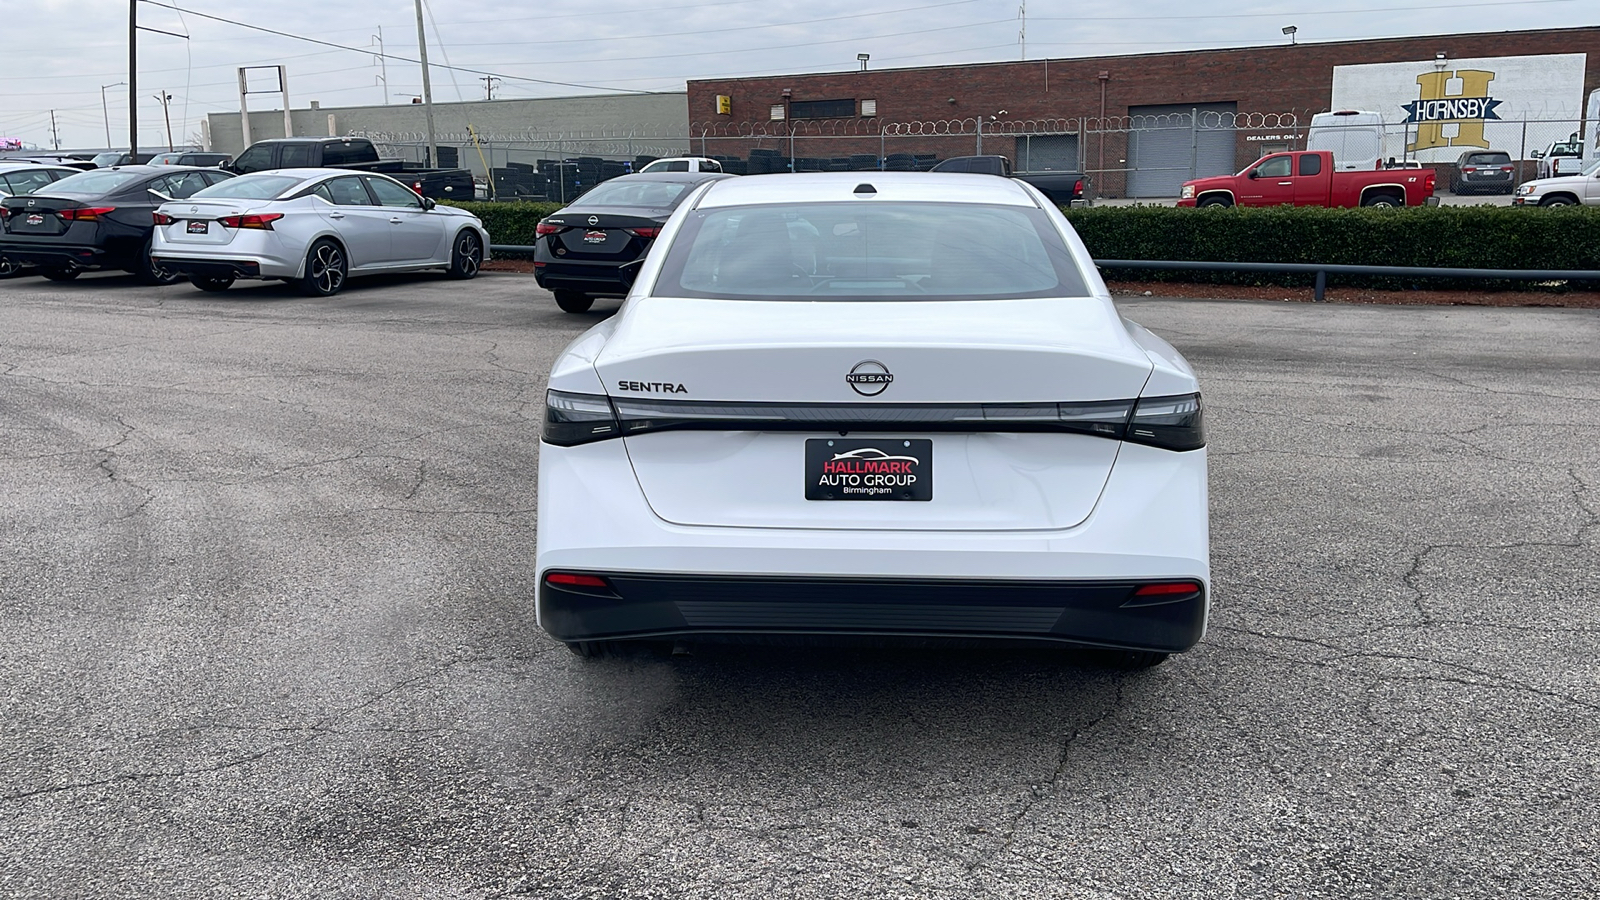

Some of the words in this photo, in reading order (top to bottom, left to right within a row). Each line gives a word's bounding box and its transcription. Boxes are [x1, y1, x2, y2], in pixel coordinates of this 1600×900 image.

[1415, 98, 1491, 121] HORNSBY
[847, 374, 893, 383] NISSAN
[618, 380, 688, 394] SENTRA
[823, 461, 913, 474] HALLMARK
[818, 474, 861, 486] AUTO
[863, 474, 917, 486] GROUP
[843, 486, 892, 496] Birmingham
